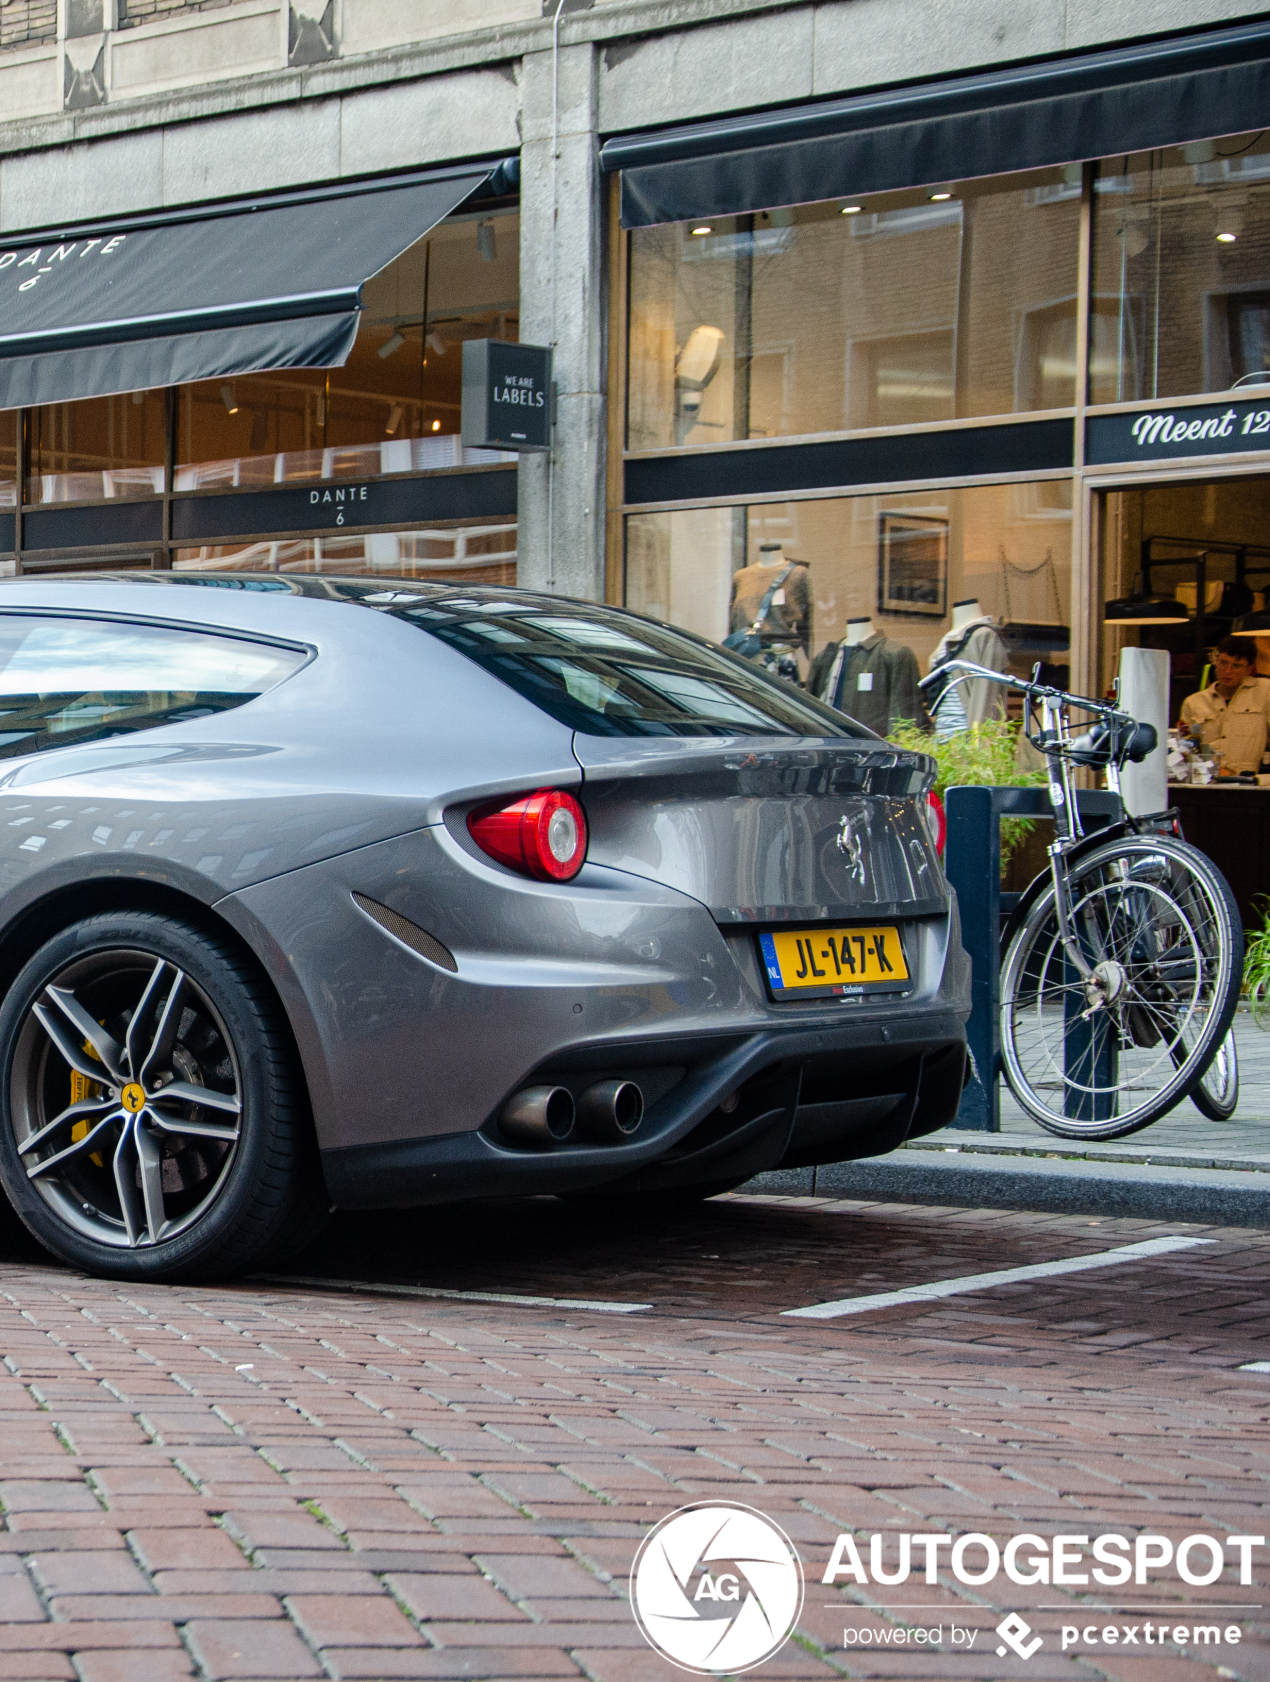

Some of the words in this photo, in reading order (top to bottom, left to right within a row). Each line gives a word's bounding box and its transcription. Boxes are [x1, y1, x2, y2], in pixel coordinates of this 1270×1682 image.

[18, 274, 41, 292] 6
[505, 375, 517, 387] WE
[518, 377, 534, 389] ARE
[493, 386, 545, 408] LABELS
[1131, 409, 1238, 446] Meent
[309, 486, 368, 504] DANTE
[336, 512, 345, 525] 6
[795, 934, 894, 979] JL-147-K
[767, 966, 781, 979] NL
